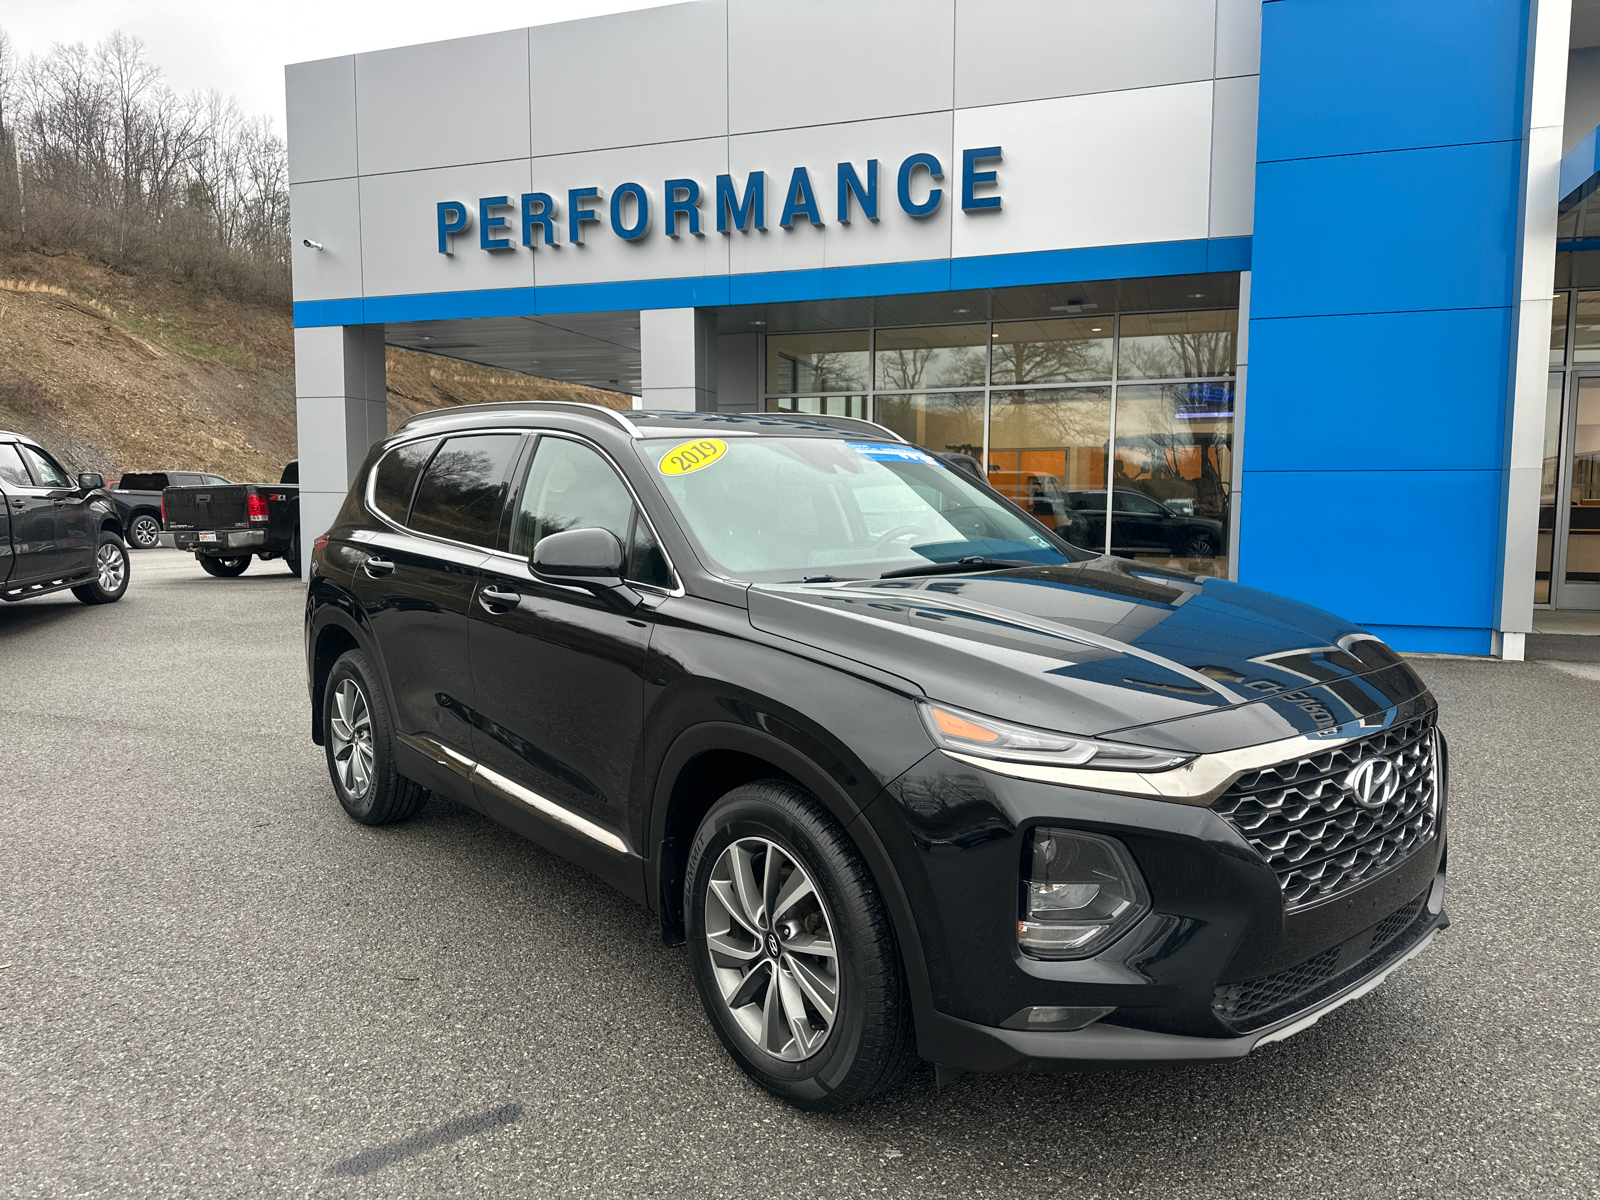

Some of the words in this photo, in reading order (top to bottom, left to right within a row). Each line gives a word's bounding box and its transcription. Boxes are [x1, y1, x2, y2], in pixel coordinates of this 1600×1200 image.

[437, 146, 1003, 255] PERFORMANCE
[671, 441, 717, 471] 2019
[685, 832, 704, 908] SUMMIT
